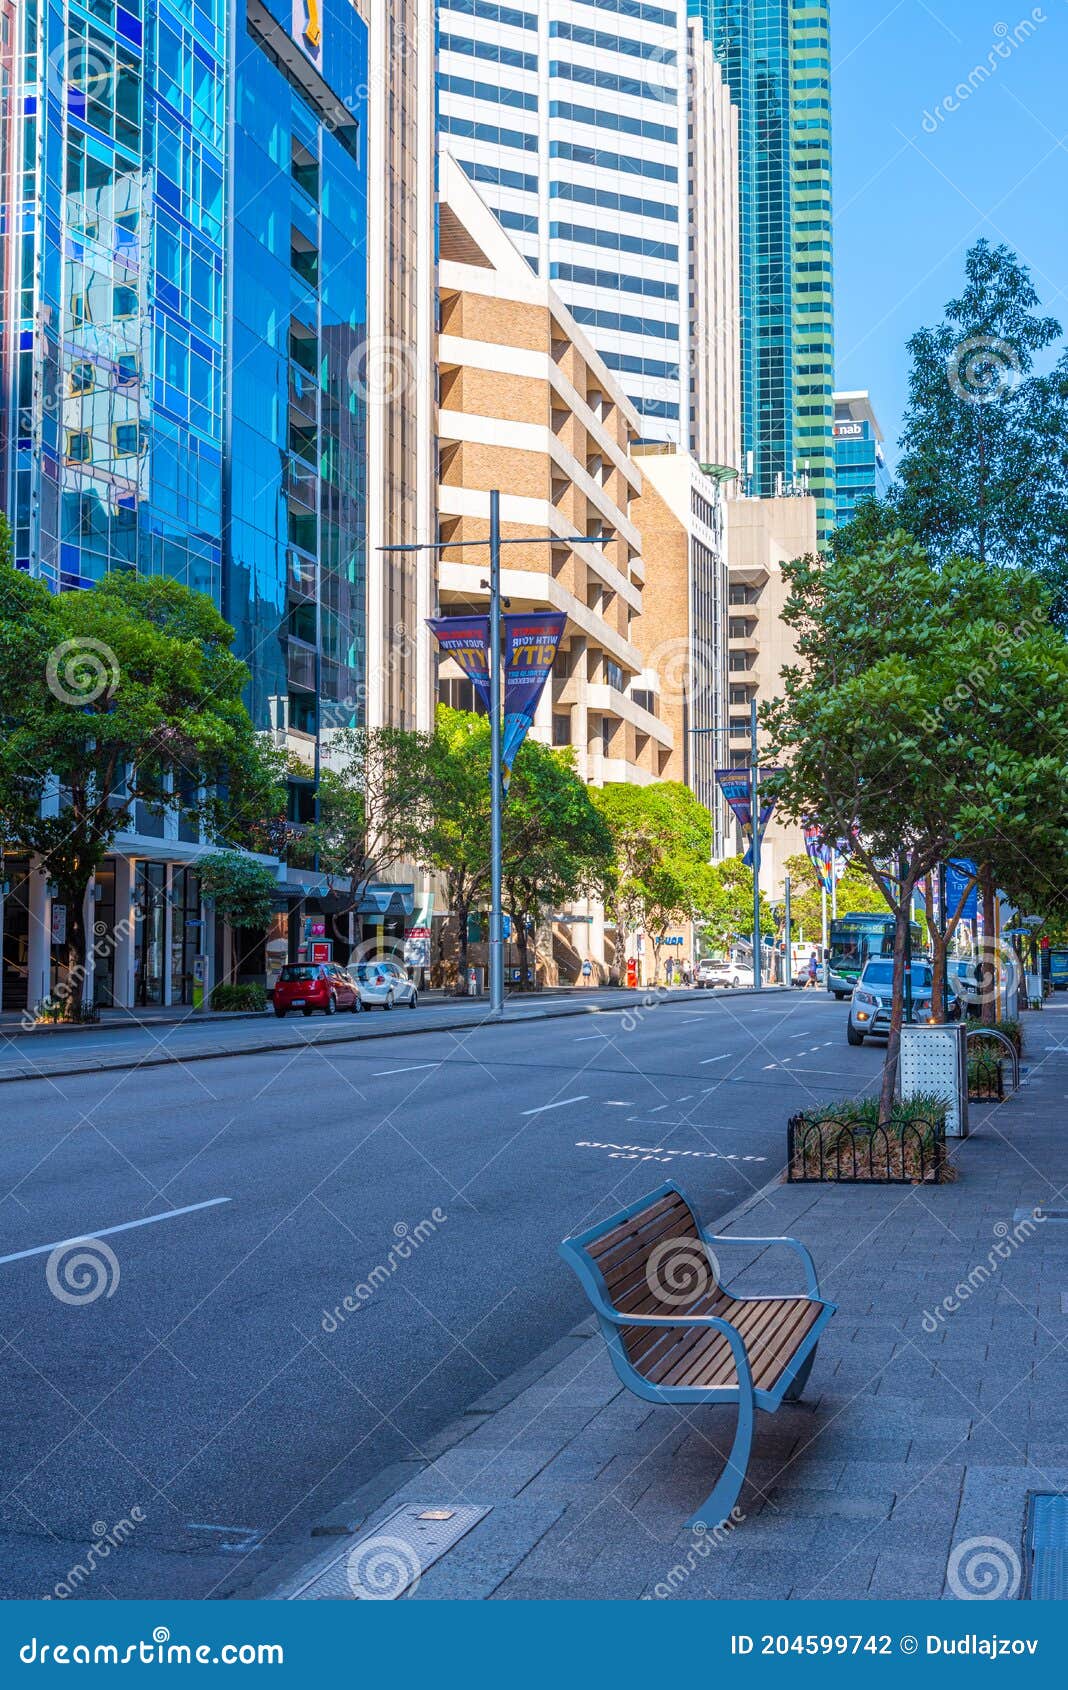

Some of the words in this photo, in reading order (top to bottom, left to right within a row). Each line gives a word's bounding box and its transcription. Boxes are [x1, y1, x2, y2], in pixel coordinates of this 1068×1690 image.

[839, 424, 861, 435] nab
[575, 1141, 768, 1162] STOPPING
[608, 1152, 673, 1162] NO
